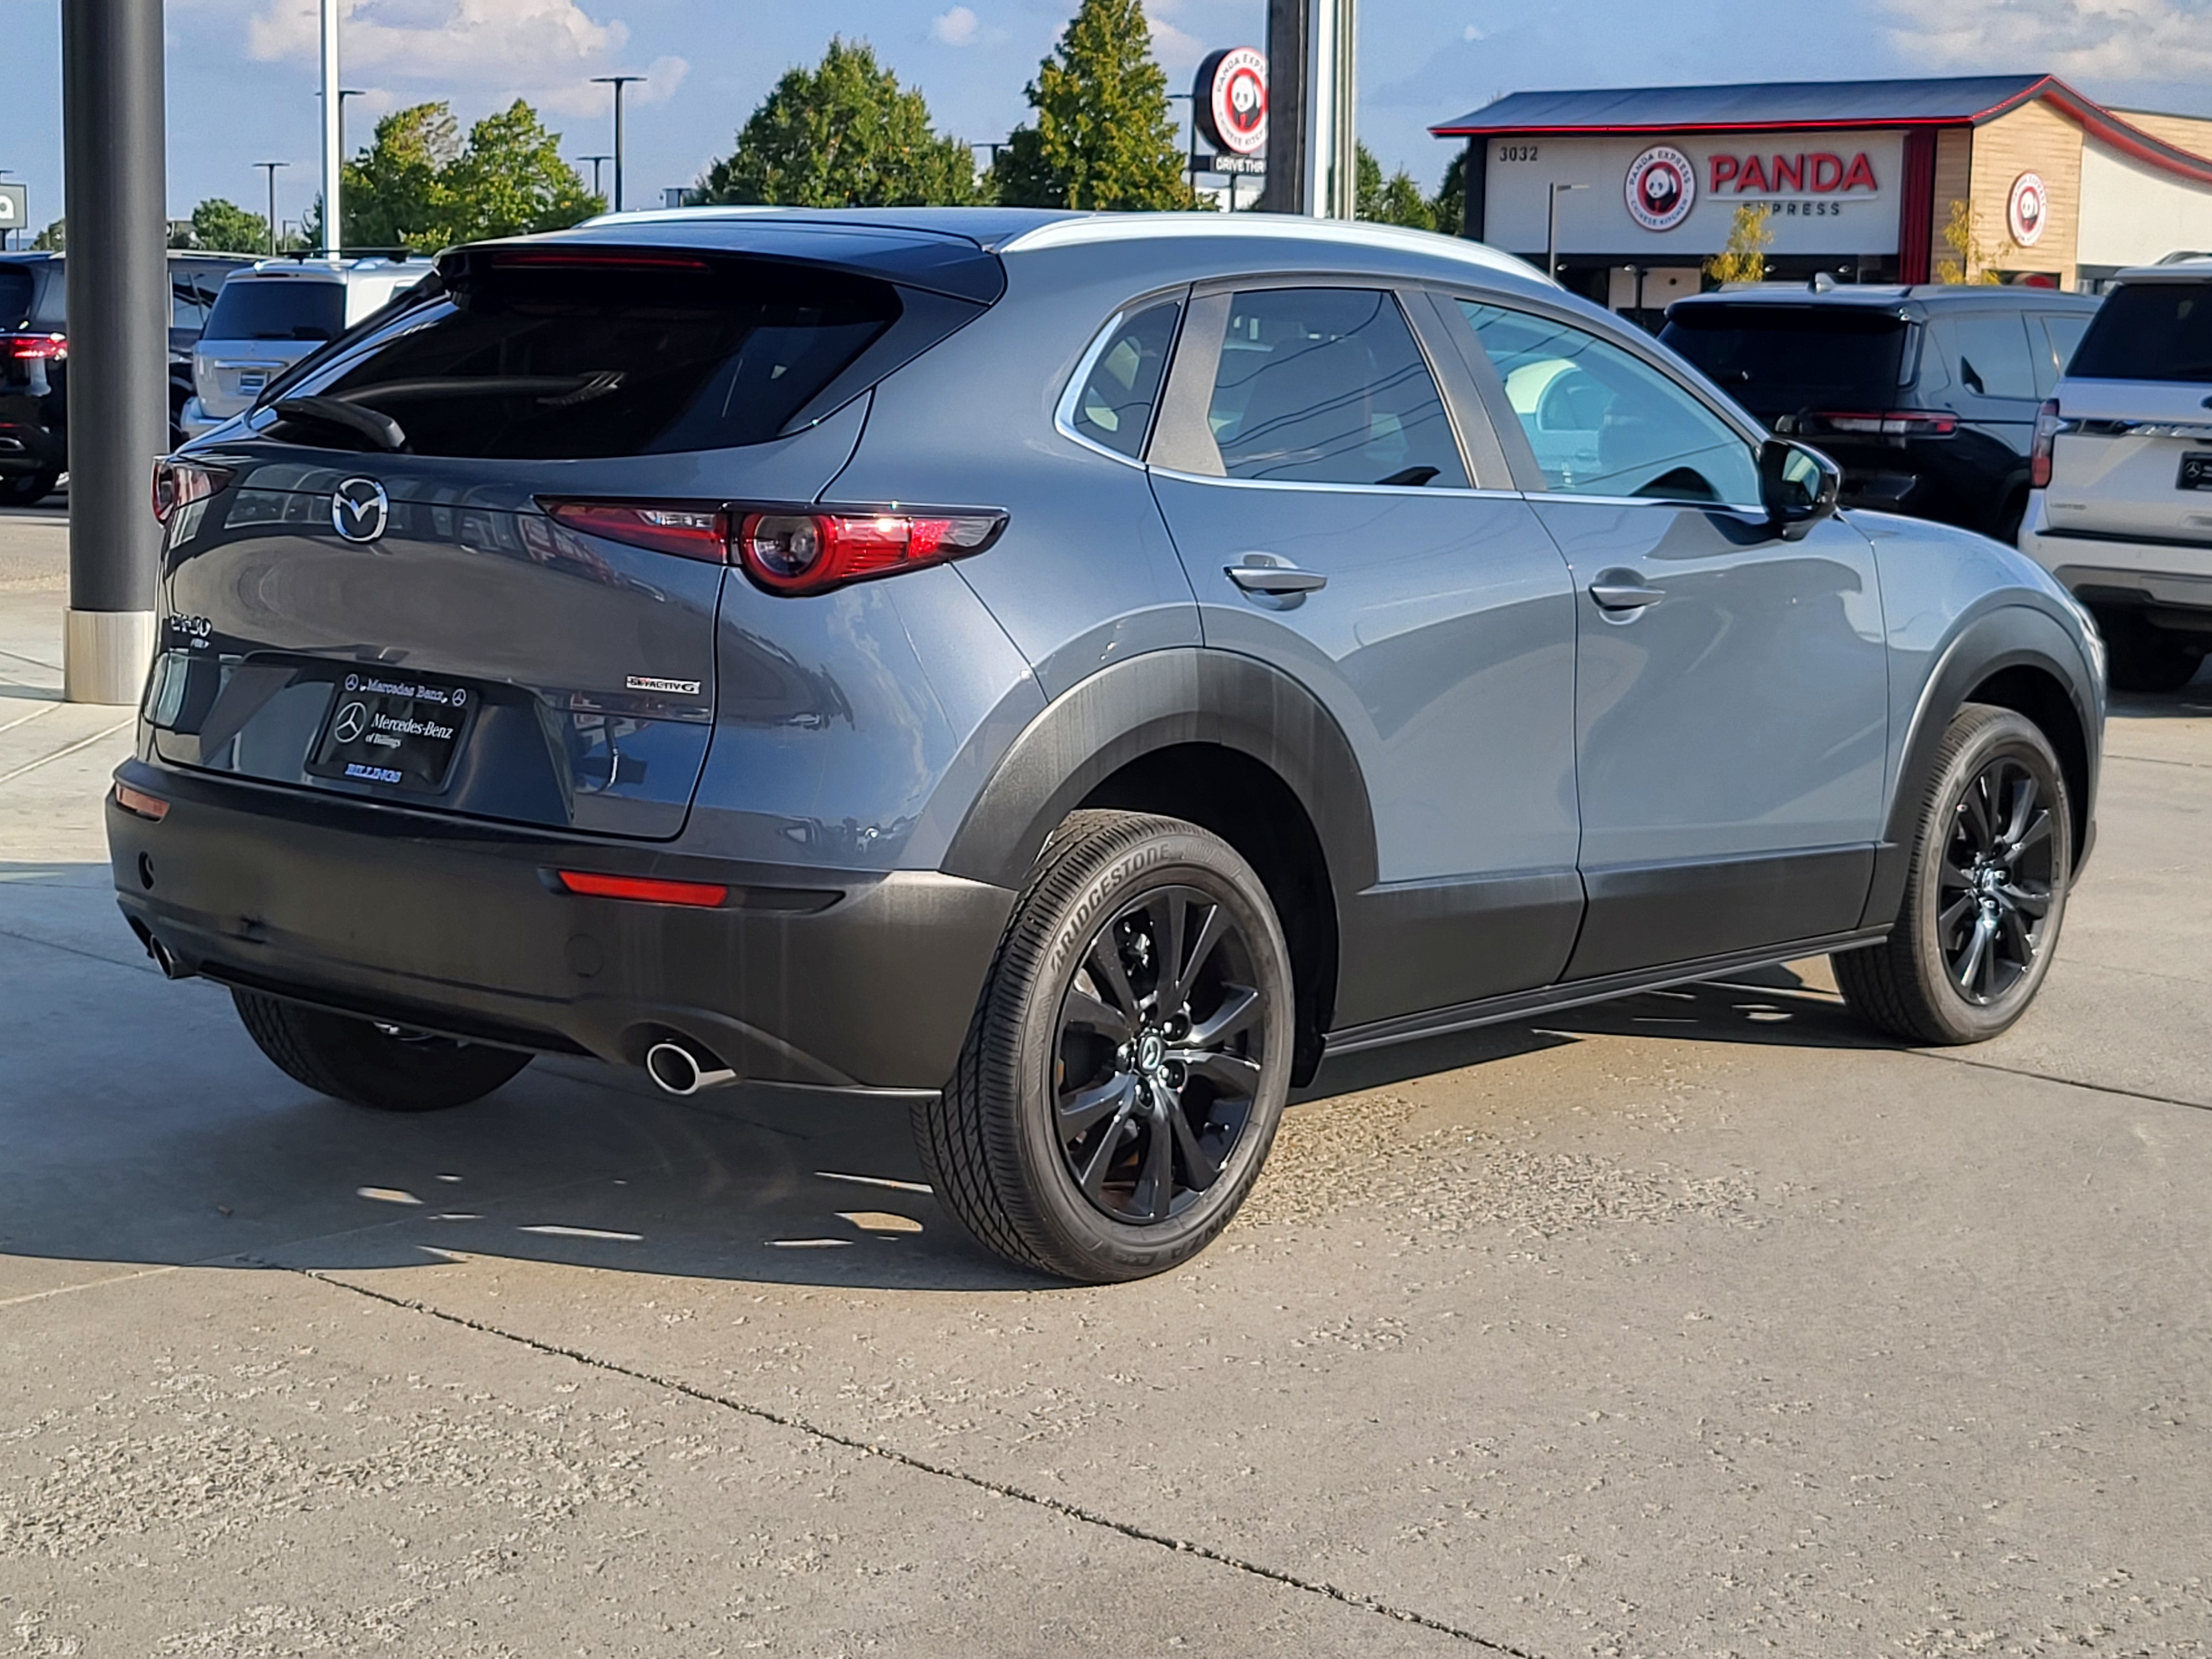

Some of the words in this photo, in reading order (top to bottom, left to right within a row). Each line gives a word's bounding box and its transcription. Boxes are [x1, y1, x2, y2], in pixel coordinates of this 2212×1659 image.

[1217, 57, 1240, 92] PANDA
[1216, 156, 1244, 173] DRIVE
[1245, 159, 1267, 173] THR
[1499, 147, 1537, 162] 3032
[1630, 153, 1653, 185] PANDA
[1658, 150, 1691, 184] EXPRESS
[1709, 153, 1878, 193] PANDA
[1631, 200, 1657, 225] CHINESE
[1743, 202, 1840, 216] EPRESS
[367, 677, 415, 697] Mercedes
[415, 685, 444, 701] Benz
[371, 713, 453, 739] Mercedes-Benz
[345, 763, 403, 783] BILLINGS
[1050, 843, 1170, 976] BRIDGESTONE
